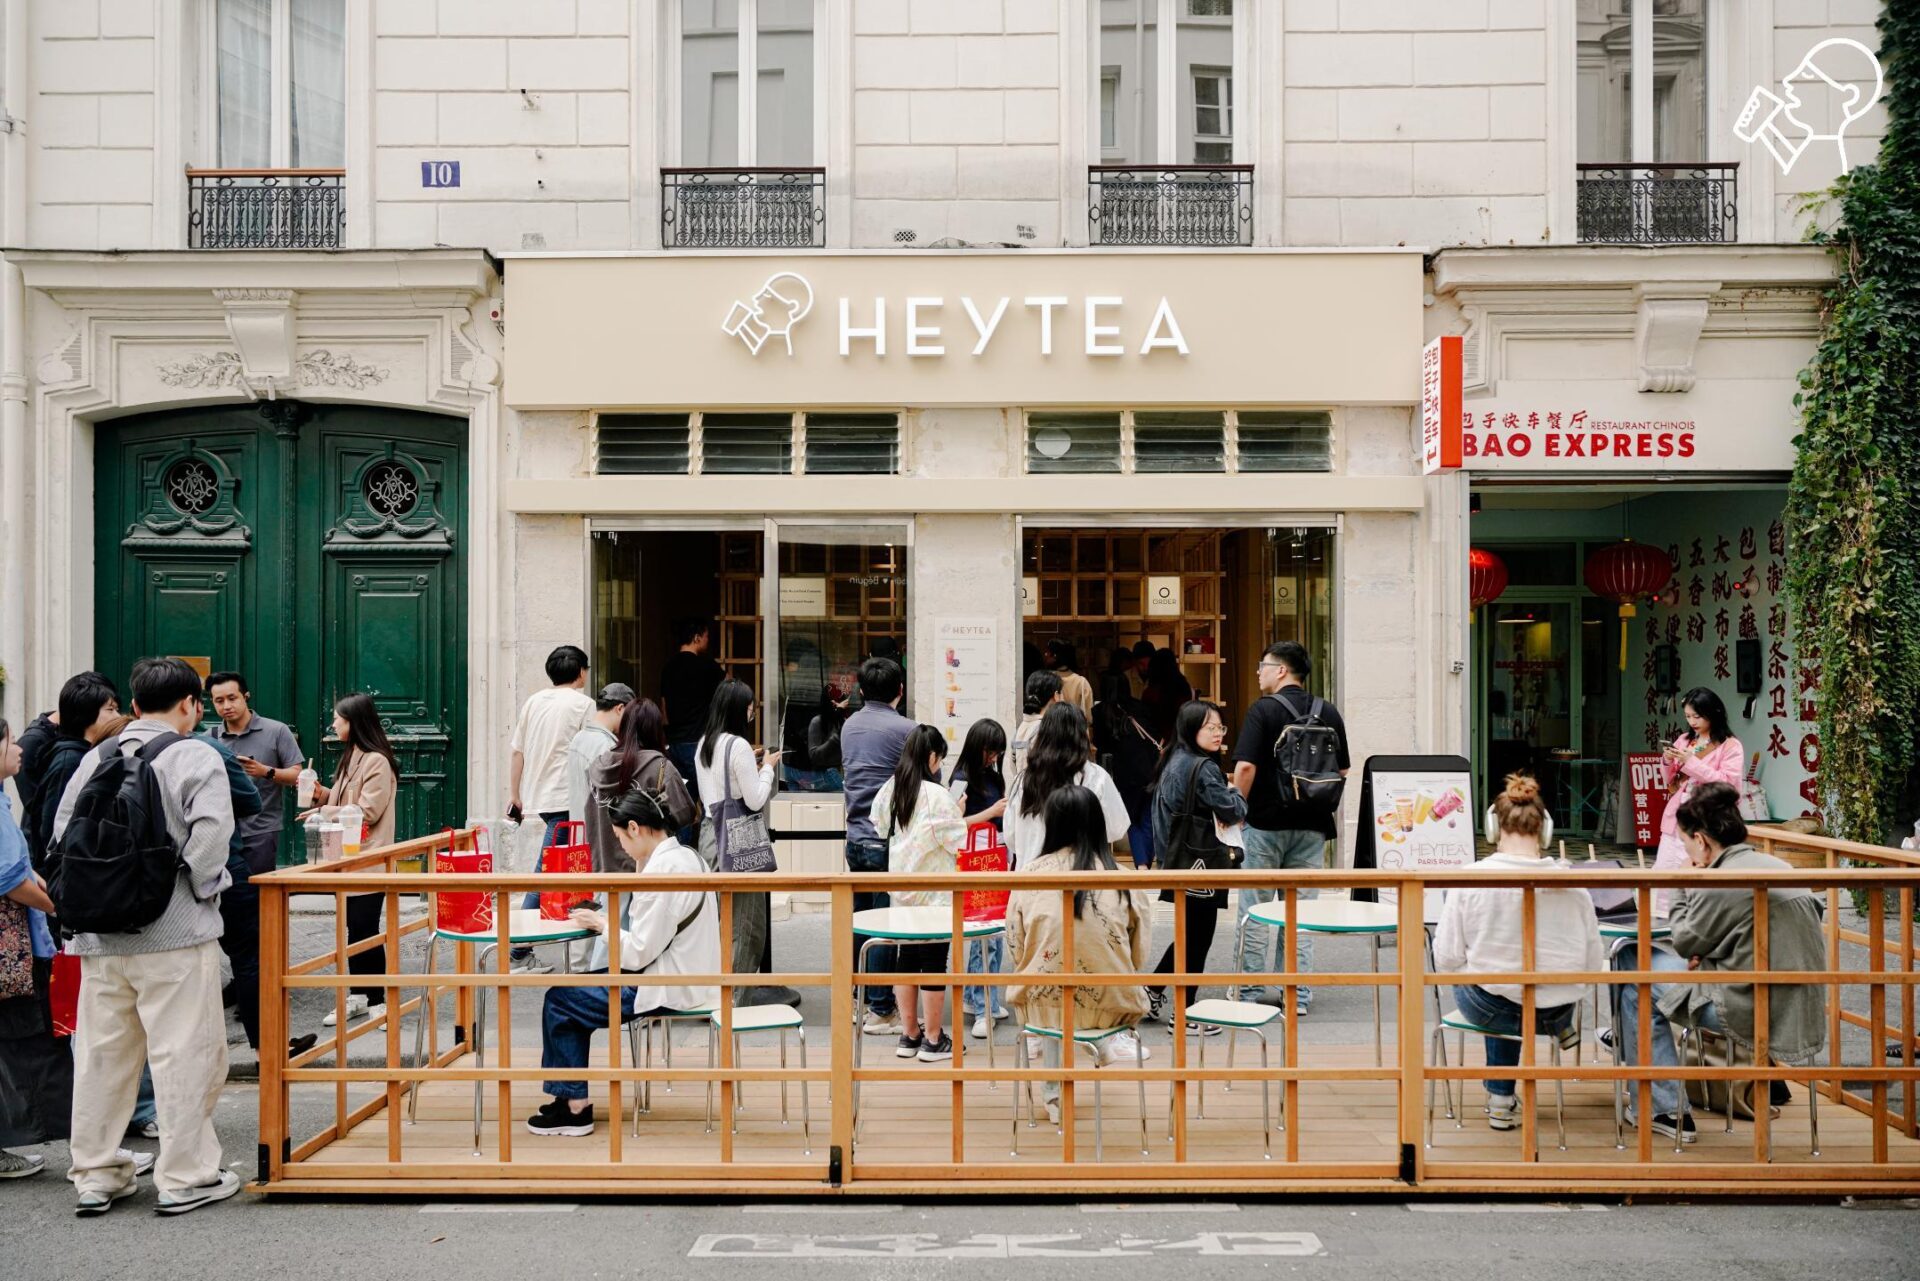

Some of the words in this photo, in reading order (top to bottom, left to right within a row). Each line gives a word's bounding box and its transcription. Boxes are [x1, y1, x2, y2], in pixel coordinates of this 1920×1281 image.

[430, 163, 452, 185] 10
[838, 296, 1191, 358] HEYTEA
[1424, 349, 1432, 414] EXPRESS
[1591, 421, 1651, 430] RESTAURANT
[1653, 421, 1695, 430] CHINOIS
[1463, 433, 1531, 457] BAO
[1545, 433, 1695, 457] EXPRESS
[952, 626, 992, 635] HEYTEA
[1631, 763, 1669, 791] OPE
[1634, 793, 1652, 844] 营业中
[969, 853, 1001, 866] HEYTEA
[1410, 842, 1468, 857] HEYTEA
